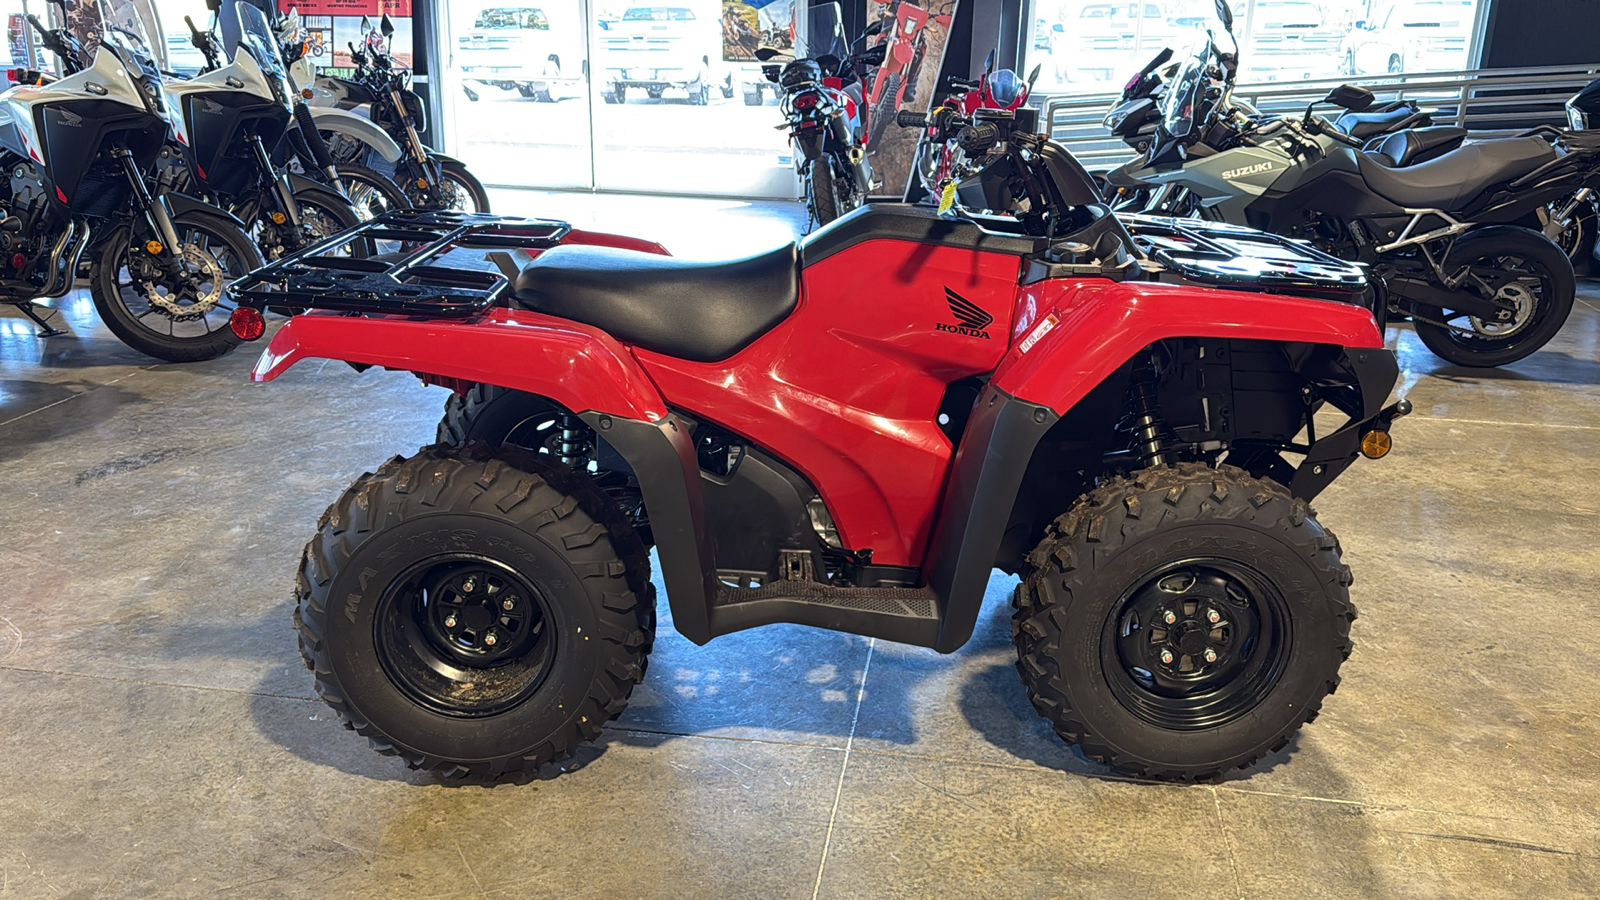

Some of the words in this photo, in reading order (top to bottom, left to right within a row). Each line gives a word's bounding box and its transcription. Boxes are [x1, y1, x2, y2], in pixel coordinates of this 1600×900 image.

[57, 120, 82, 128] HONDA
[1221, 161, 1273, 180] SUZUKI
[935, 322, 991, 340] HONDA
[345, 527, 478, 625] MAXXIS
